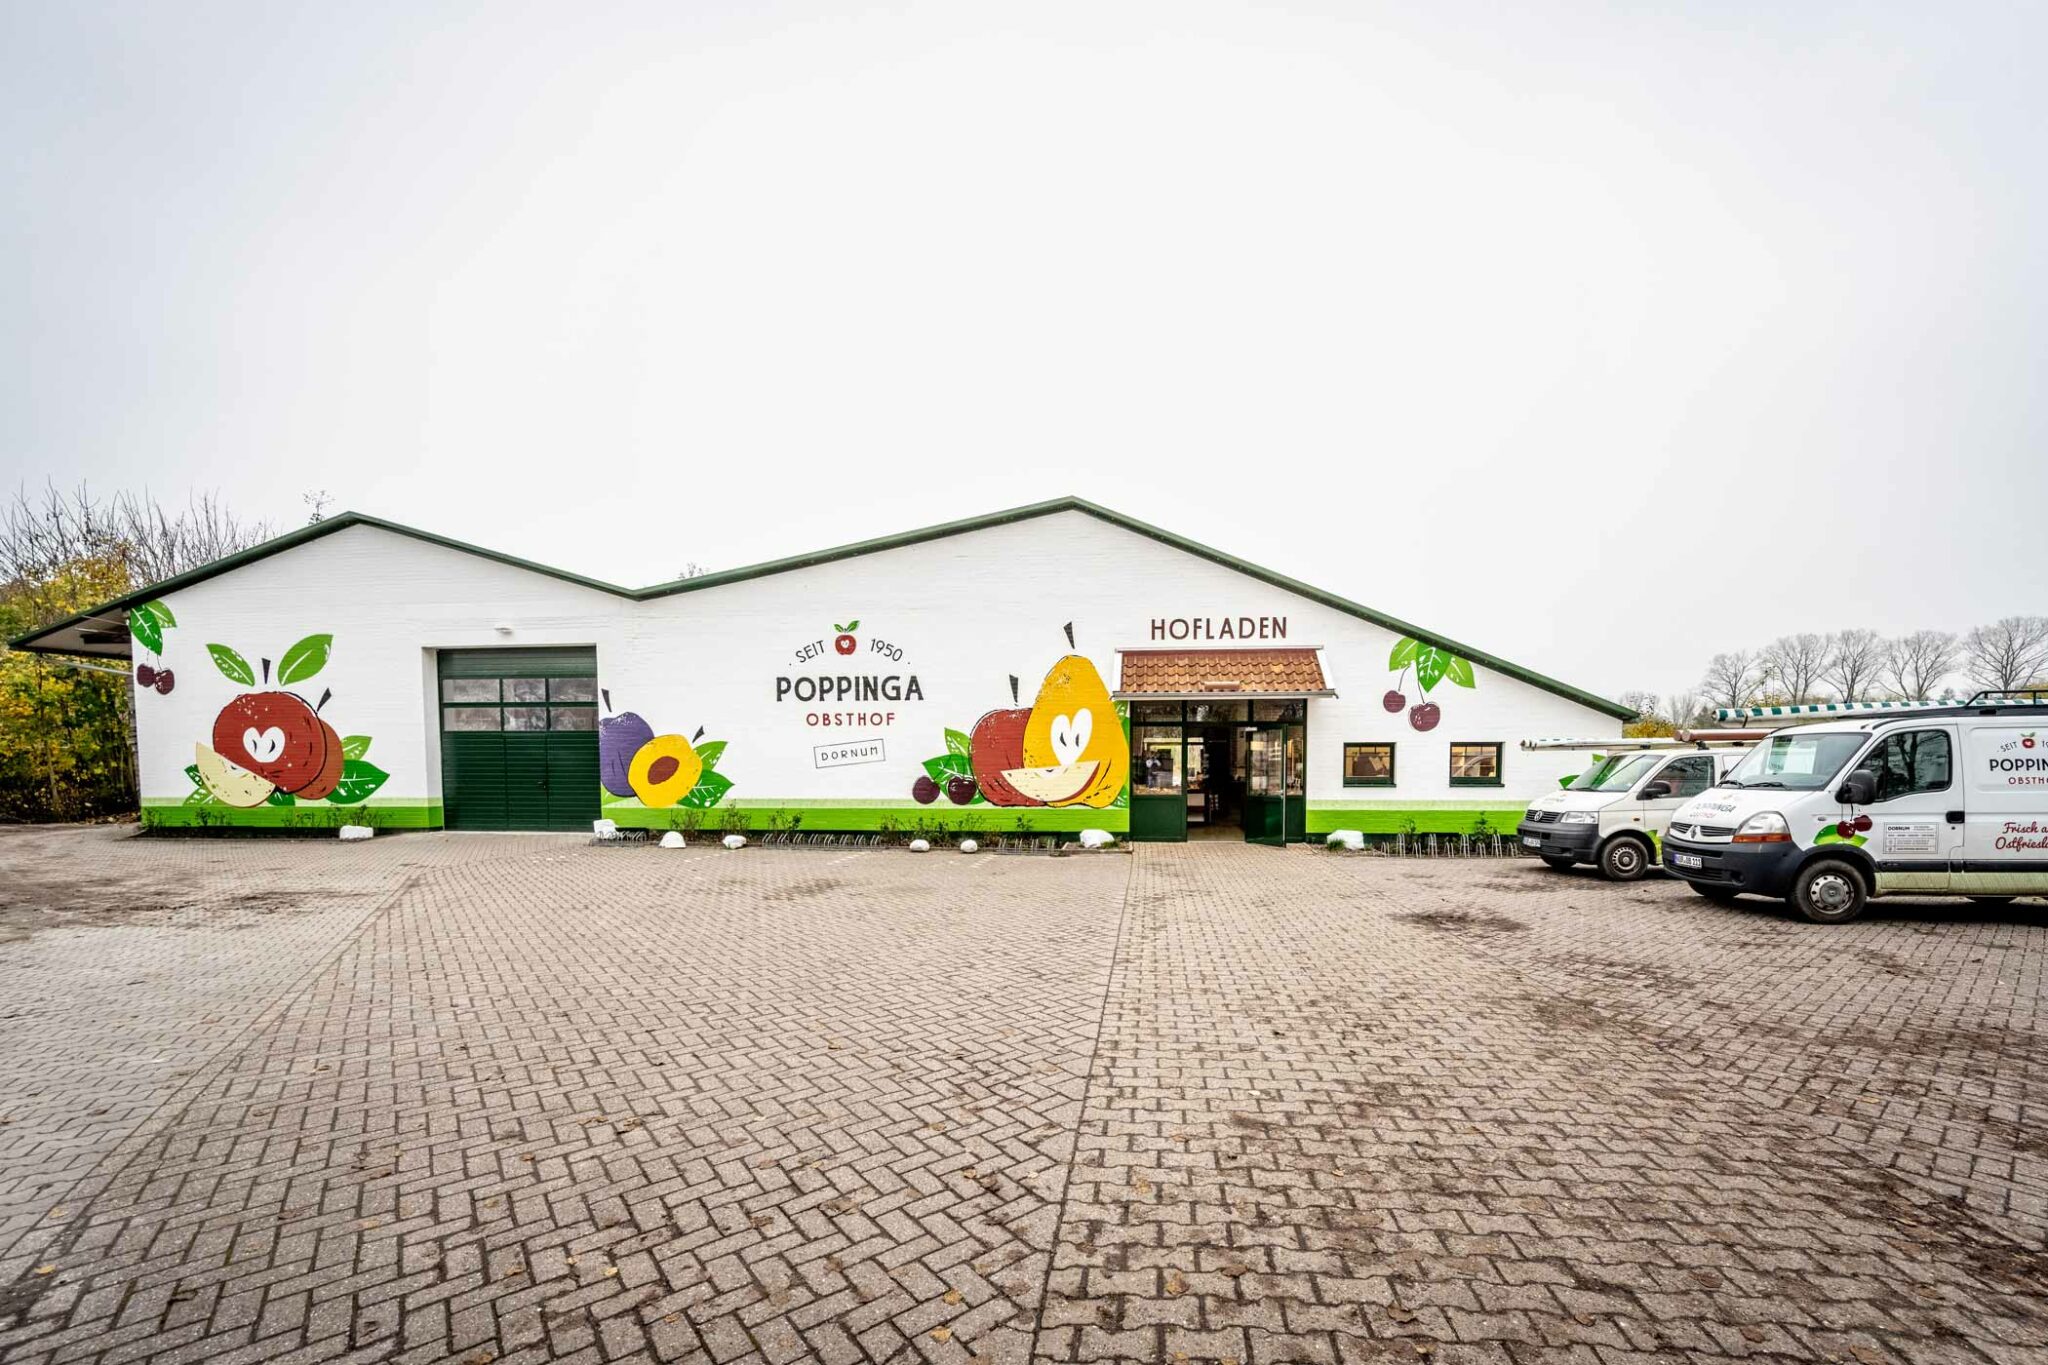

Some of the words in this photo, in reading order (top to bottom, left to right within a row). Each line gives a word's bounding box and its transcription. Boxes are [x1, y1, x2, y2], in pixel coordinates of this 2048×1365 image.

[1151, 616, 1288, 641] HOFLADEN
[795, 640, 825, 663] SEIT
[870, 638, 903, 662] 1950
[776, 675, 924, 702] POPPINGA
[806, 712, 896, 727] OBSTHOF
[821, 746, 879, 761] DORNUM
[2000, 741, 2018, 753] SEIT
[2008, 777, 2048, 785] OBSTH
[2002, 821, 2039, 834] Frisch
